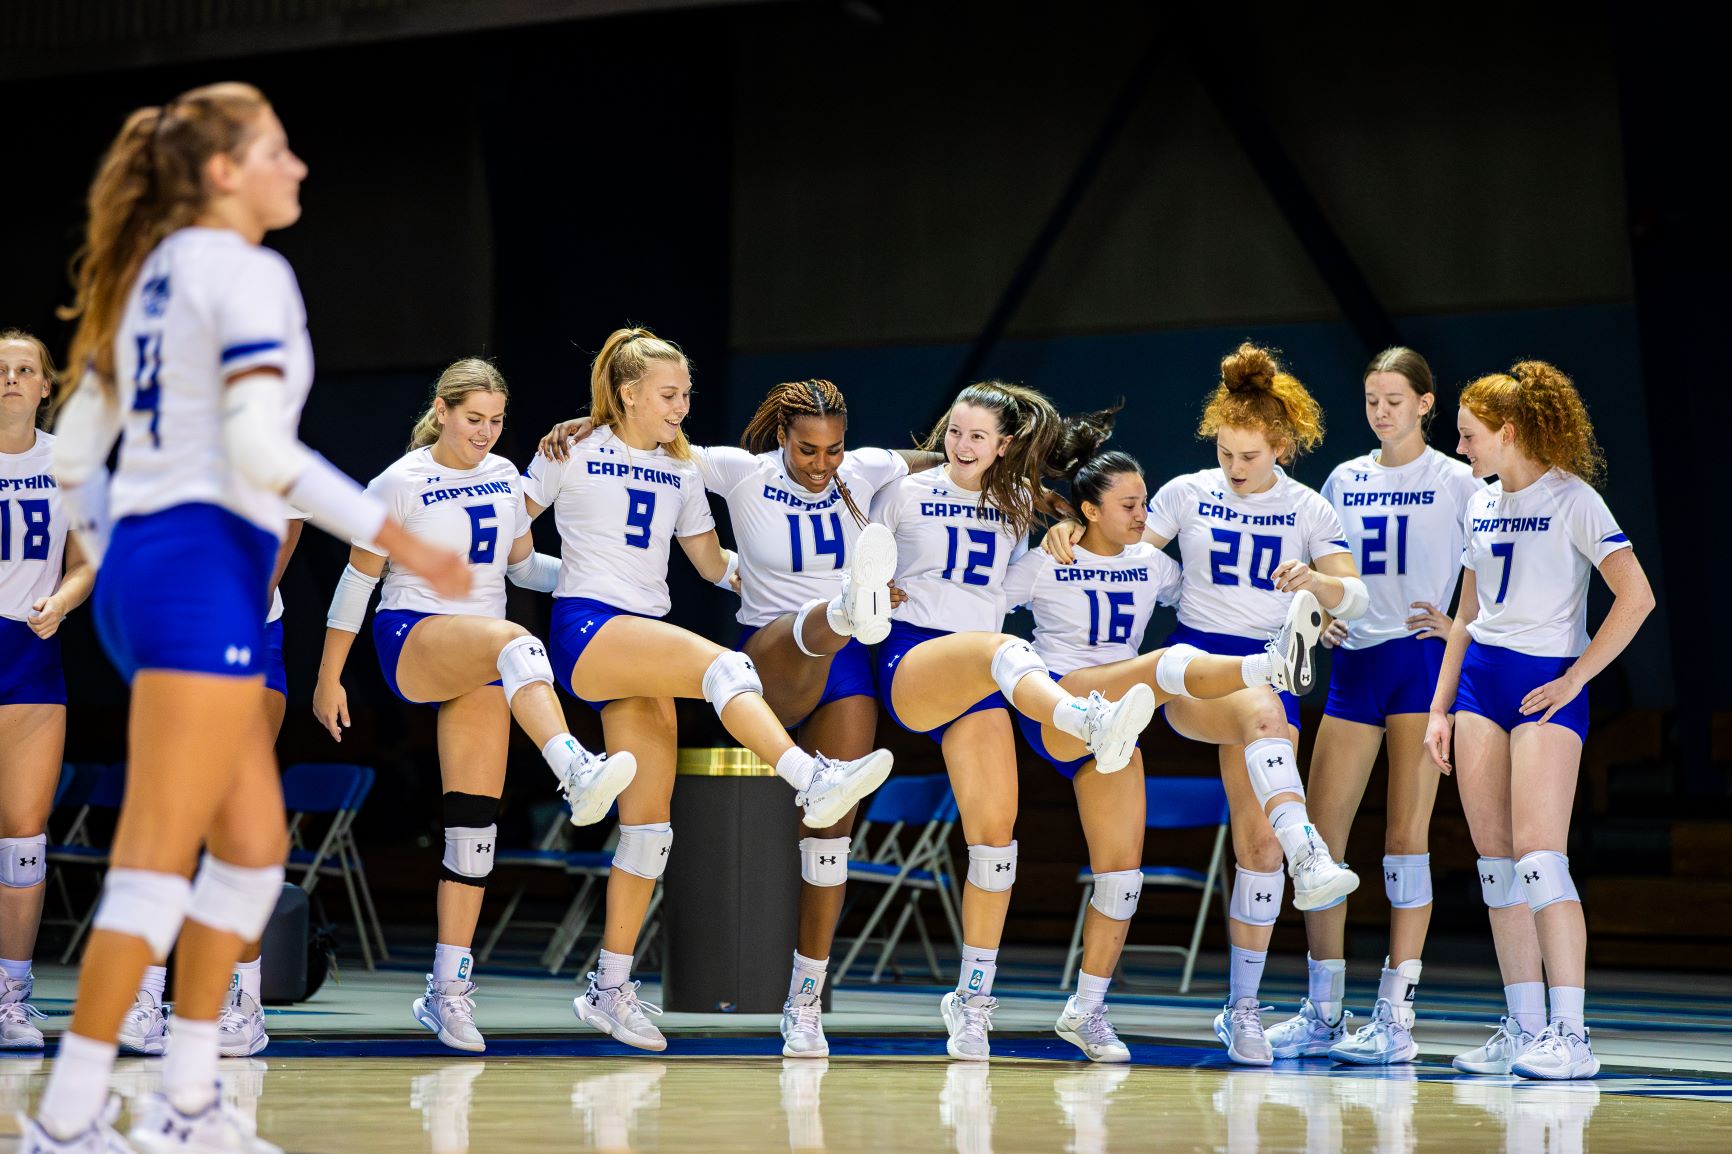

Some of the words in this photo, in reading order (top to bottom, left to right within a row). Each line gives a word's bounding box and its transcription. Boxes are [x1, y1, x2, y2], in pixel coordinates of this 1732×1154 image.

[0, 474, 56, 492] PTAIN
[420, 481, 512, 507] CAPTAINS
[586, 461, 682, 490] CAPTAINS
[1343, 490, 1436, 507] CAPTAINS
[0, 498, 51, 561] 18
[463, 503, 499, 564] 6
[624, 487, 656, 550] 9
[786, 512, 845, 573] 14
[1198, 501, 1297, 527] CAPTAINS
[1472, 516, 1552, 533] CAPTAINS
[941, 525, 997, 586] 12
[1054, 567, 1150, 583] CAPTAINS
[1210, 527, 1283, 592] 20
[1360, 514, 1409, 577] 21
[1490, 542, 1517, 604] 7
[1083, 589, 1136, 647] 16
